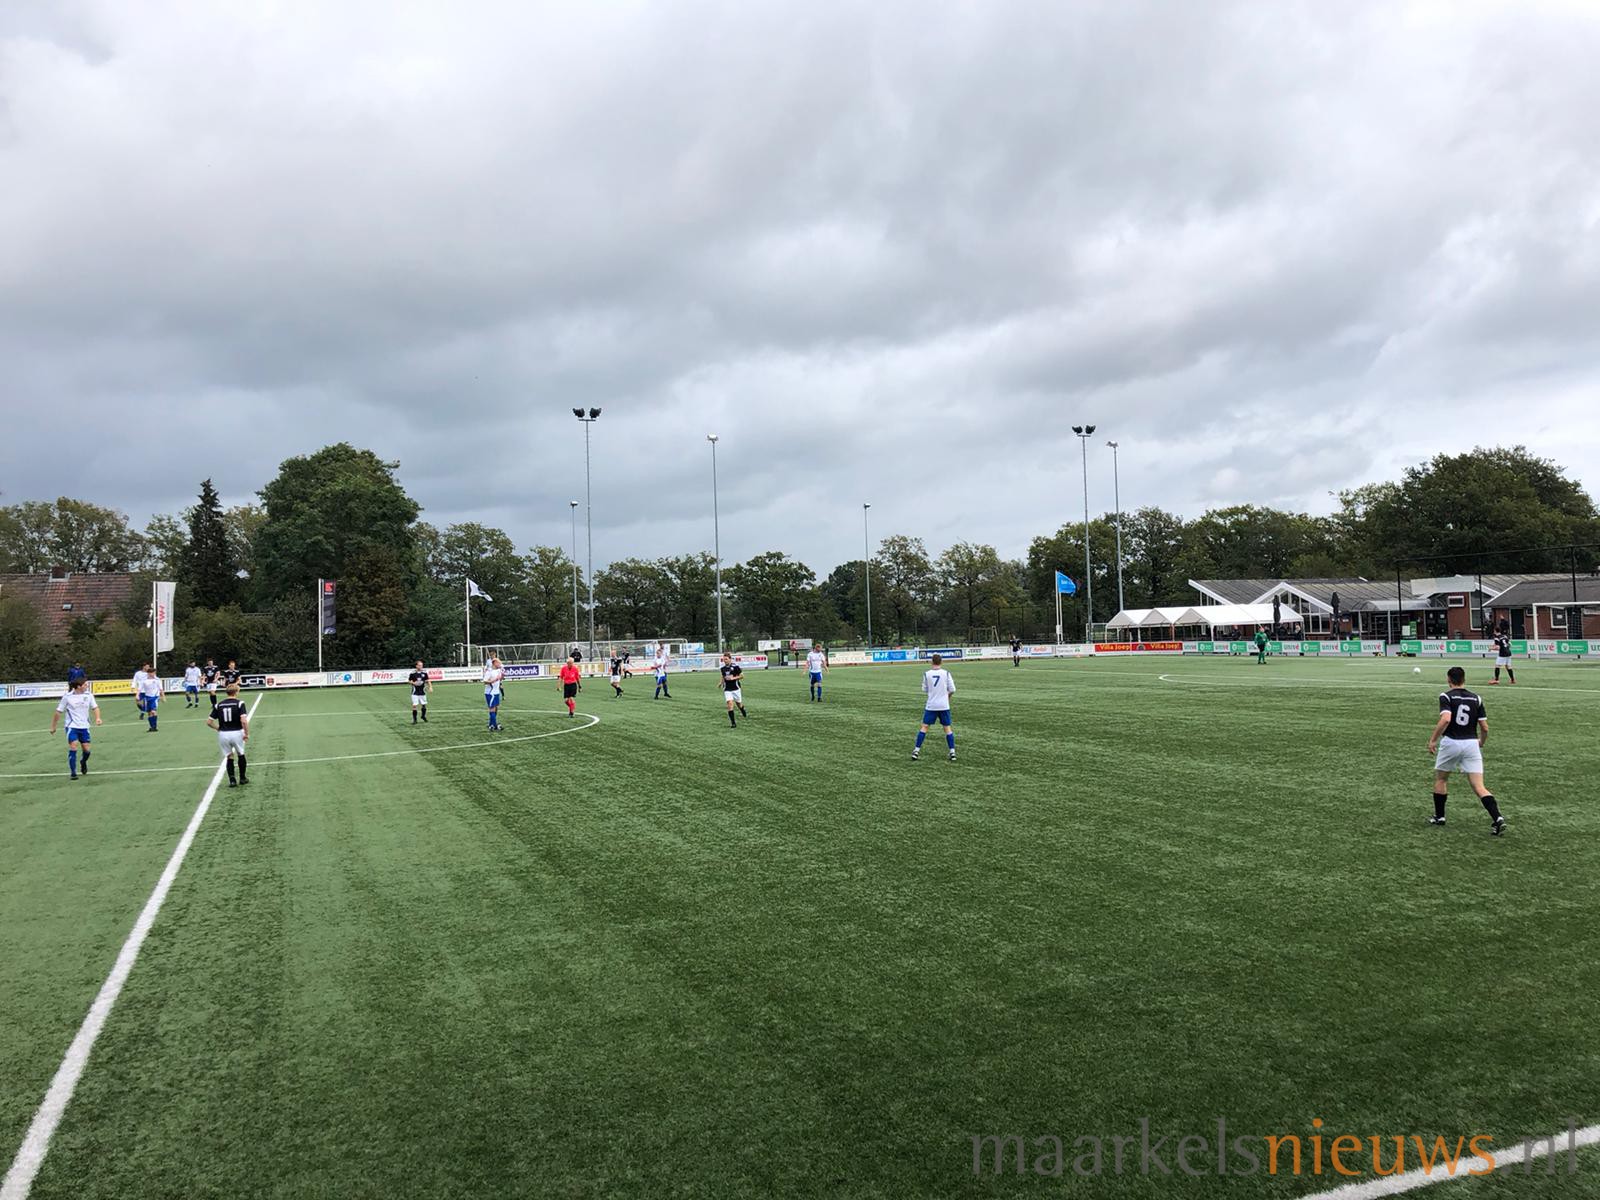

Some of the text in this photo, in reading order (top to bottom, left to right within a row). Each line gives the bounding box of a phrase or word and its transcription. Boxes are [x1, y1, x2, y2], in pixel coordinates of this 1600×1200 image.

[371, 671, 394, 679] Prins
[932, 675, 941, 687] 7
[222, 707, 233, 722] 11
[1455, 703, 1470, 726] 6
